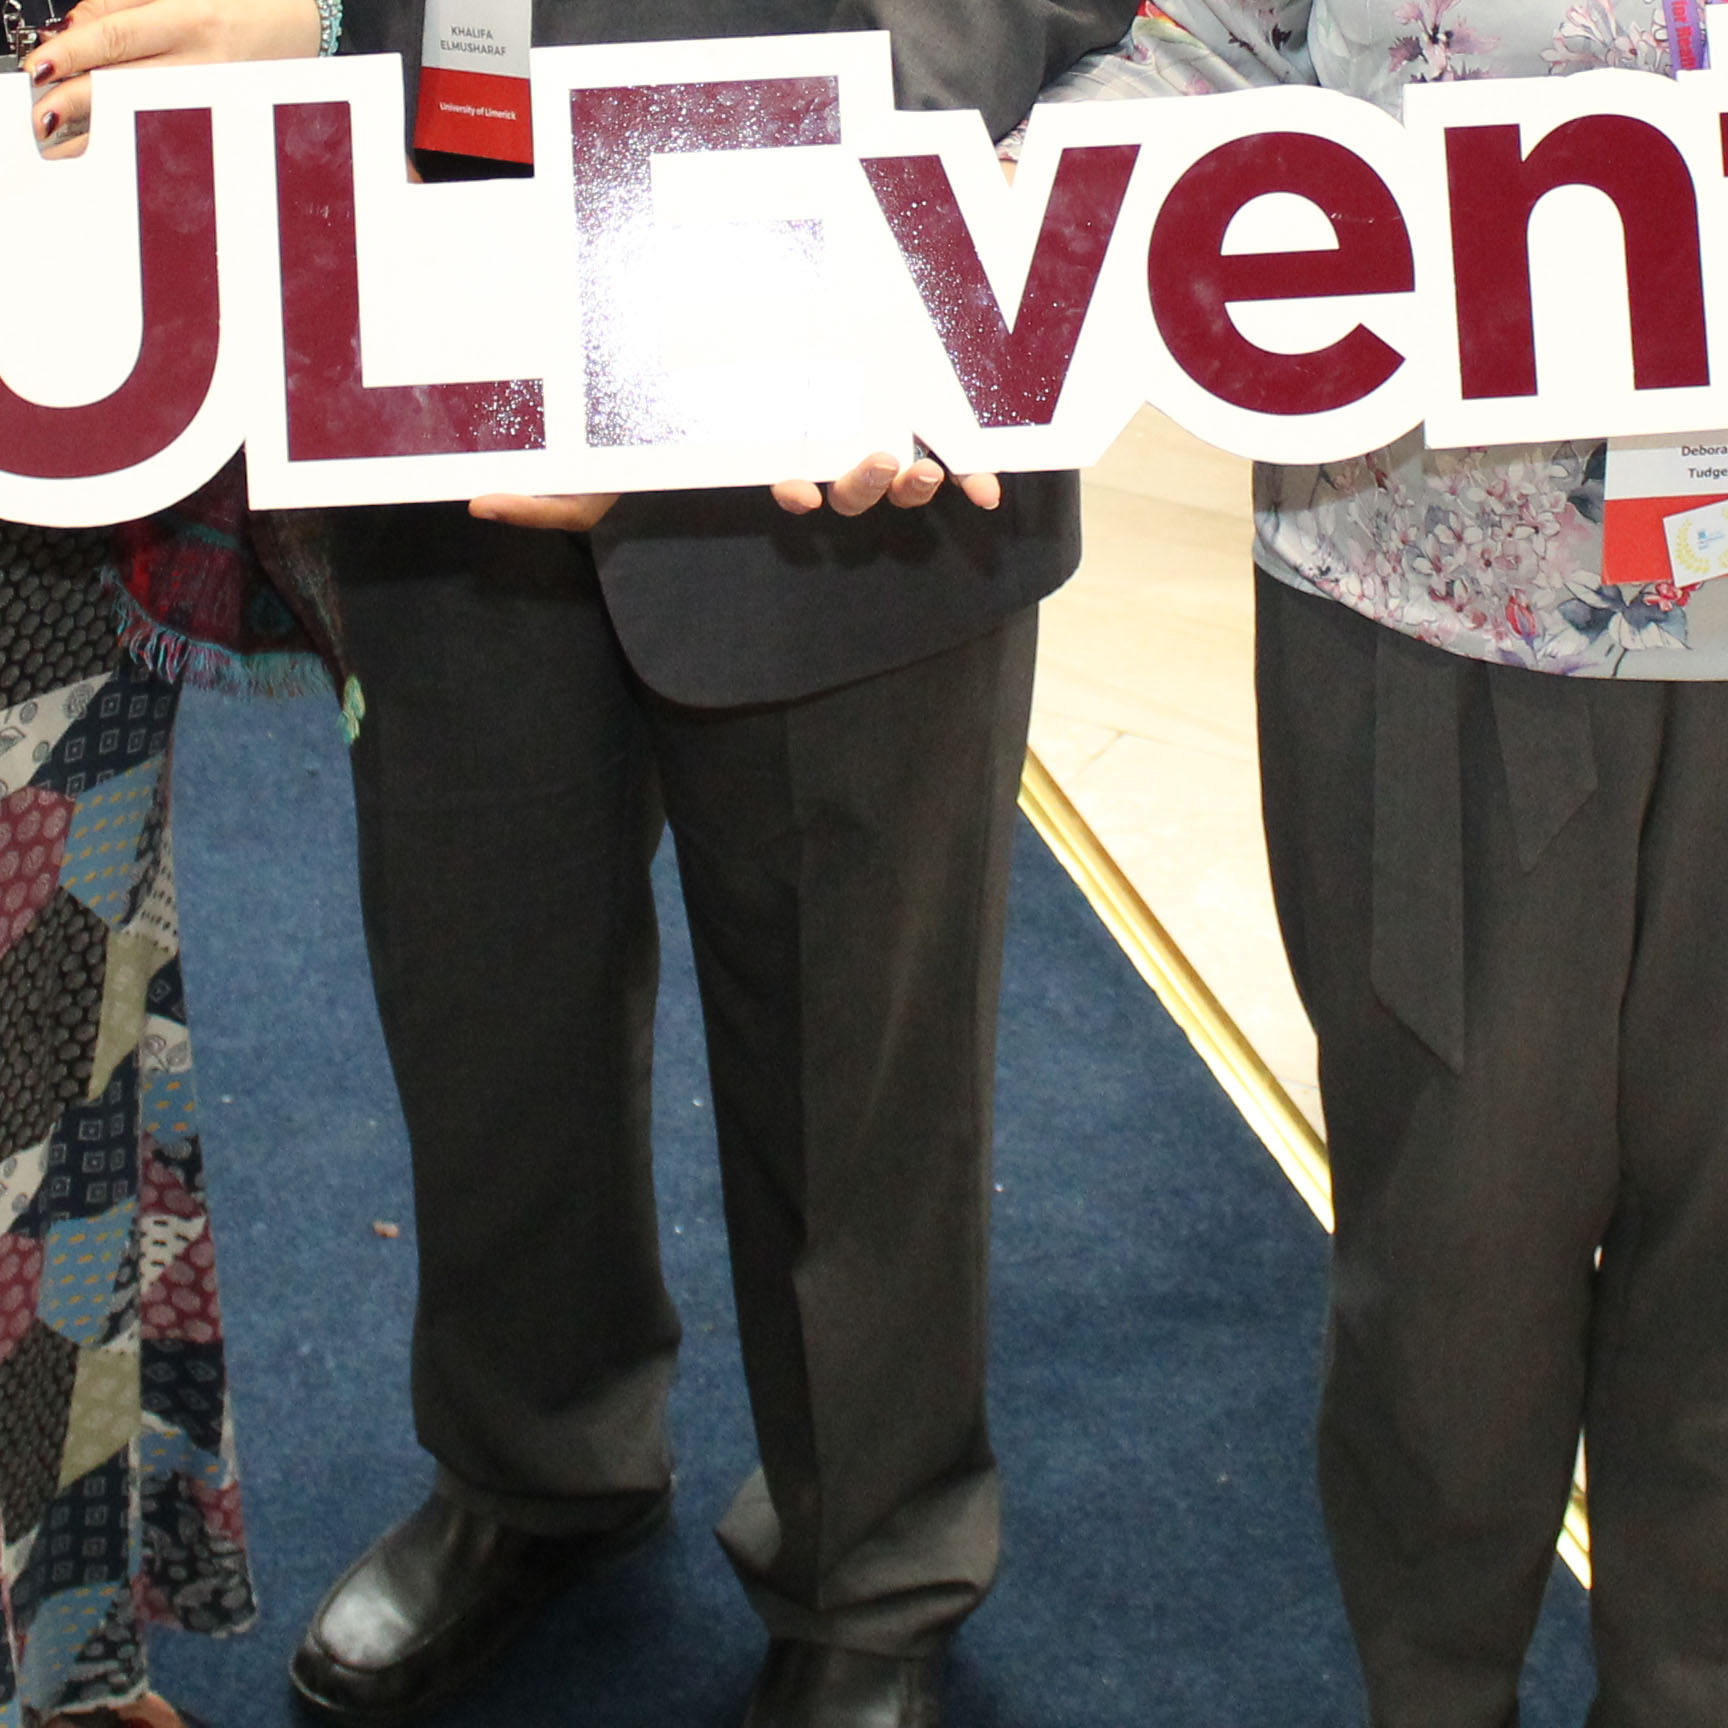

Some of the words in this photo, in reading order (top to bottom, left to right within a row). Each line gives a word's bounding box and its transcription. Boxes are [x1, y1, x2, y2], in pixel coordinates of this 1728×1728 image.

[450, 25, 494, 40] KHALIFA
[440, 40, 507, 57] ELMUSHARAF
[1675, 25, 1697, 71] Healt
[439, 101, 475, 117] University
[476, 106, 485, 116] of
[484, 107, 517, 121] Limerick
[1688, 466, 1728, 480] Tudge
